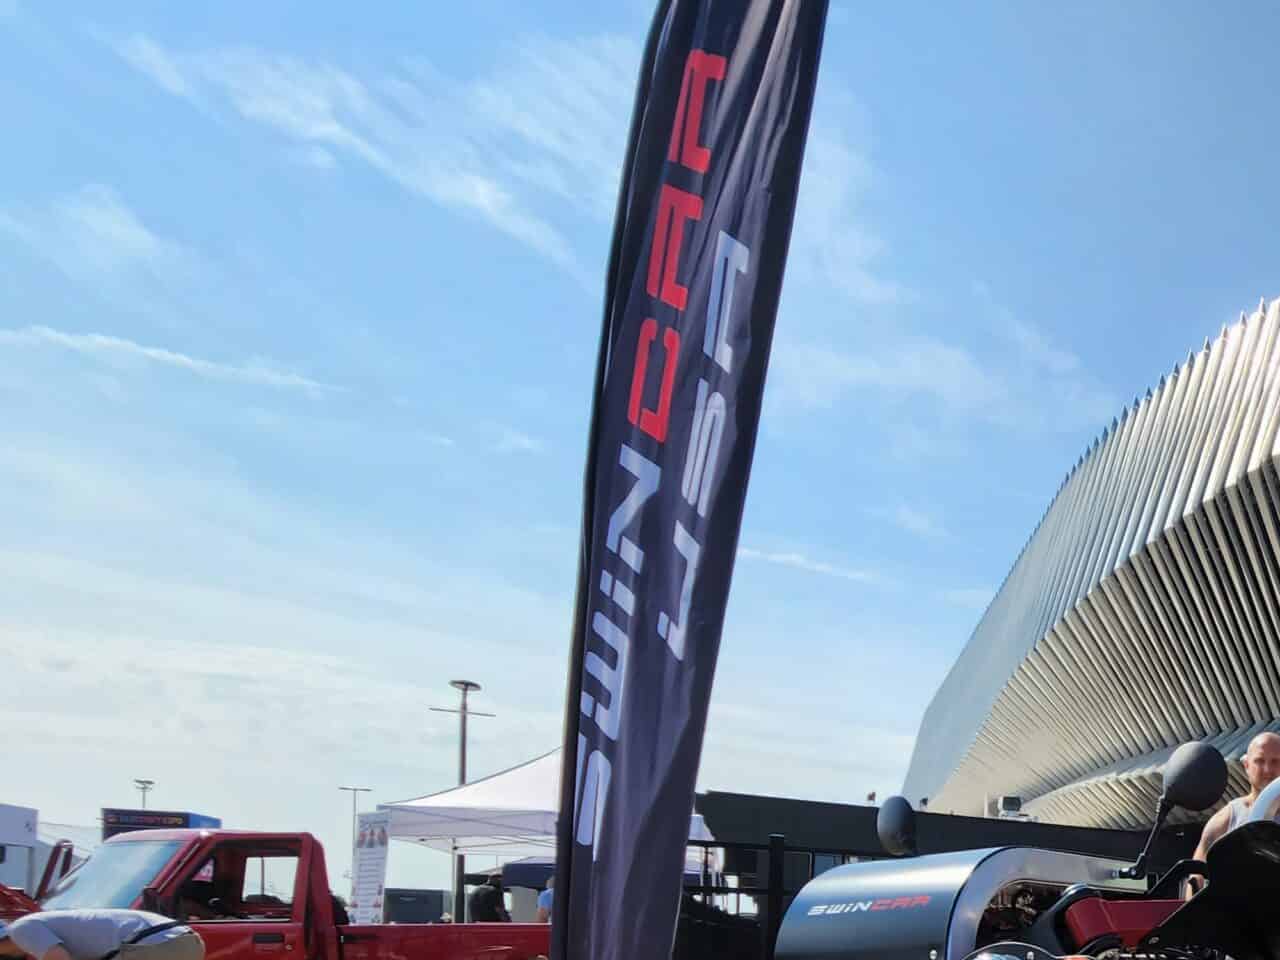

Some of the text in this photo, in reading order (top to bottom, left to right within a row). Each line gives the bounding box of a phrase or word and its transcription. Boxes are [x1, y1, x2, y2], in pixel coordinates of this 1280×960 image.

[574, 48, 728, 863] SWINCAR
[656, 229, 750, 661] USA
[807, 895, 930, 916] SWINCAR
